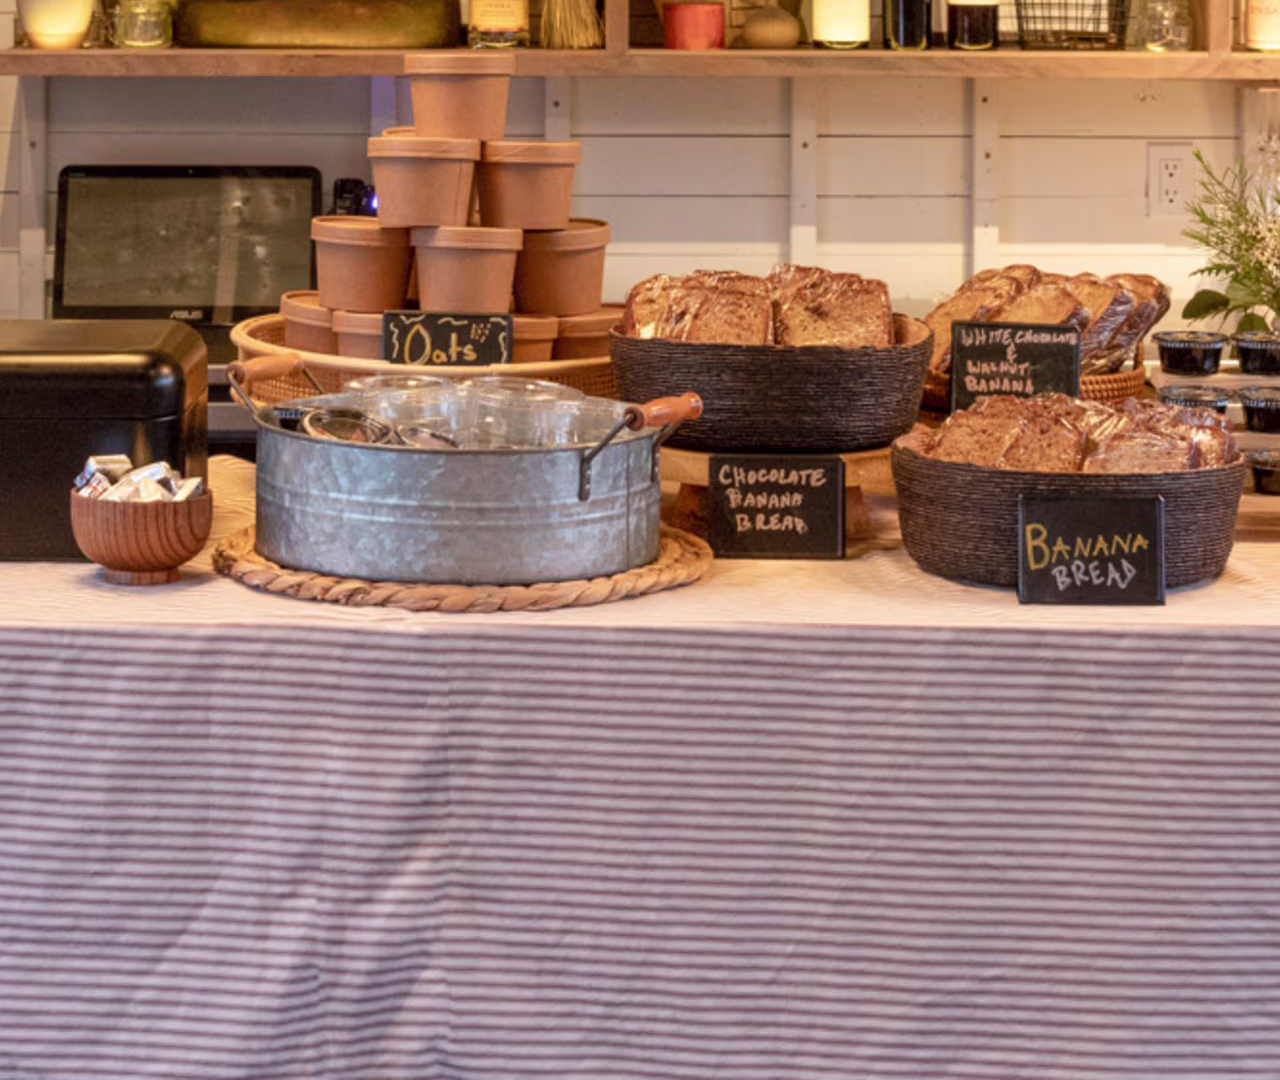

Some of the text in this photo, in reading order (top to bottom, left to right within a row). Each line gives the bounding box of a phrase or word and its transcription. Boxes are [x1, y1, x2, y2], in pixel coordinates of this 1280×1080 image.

[404, 323, 478, 366] Oats
[961, 328, 1013, 347] WHITE
[966, 360, 1030, 376] WALNUT
[964, 375, 1034, 395] BANANA
[719, 464, 827, 488] CHOCOLATE
[735, 513, 809, 535] BREAD
[1025, 523, 1150, 571] BANANA
[1051, 559, 1137, 592] BREAD
